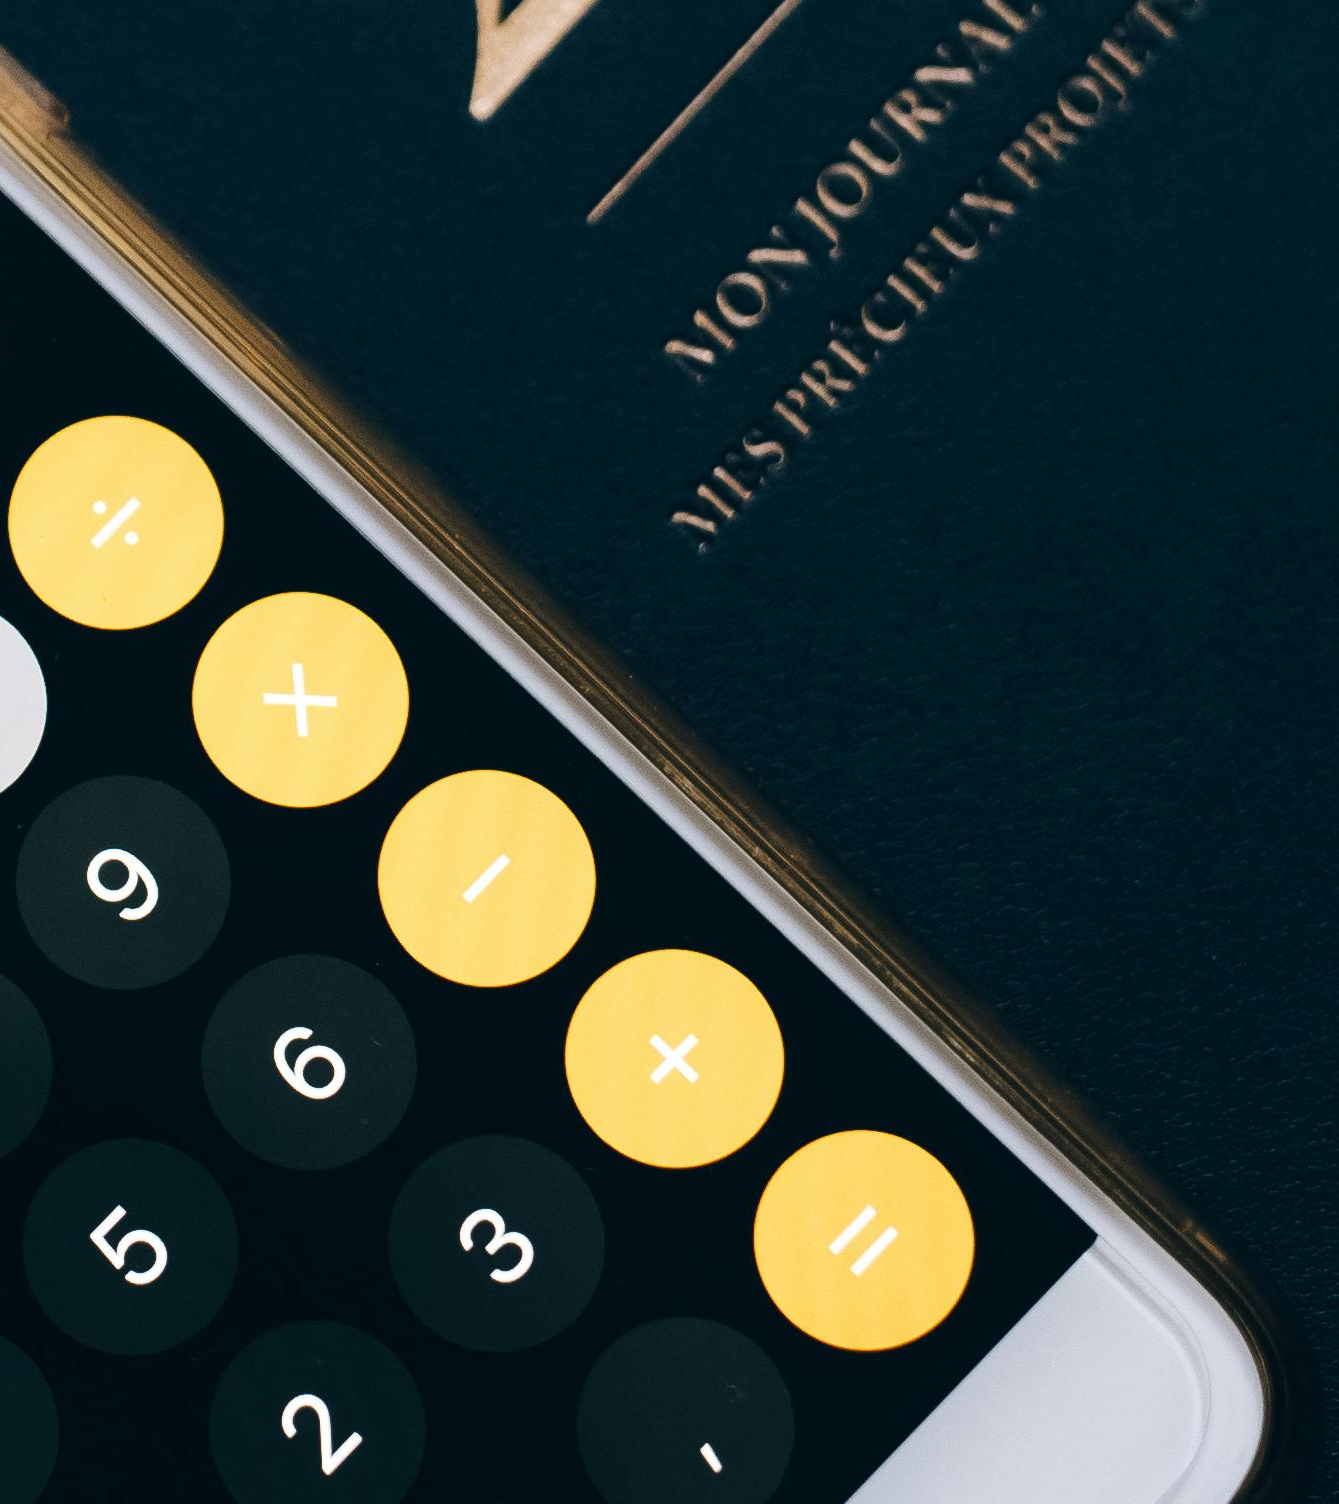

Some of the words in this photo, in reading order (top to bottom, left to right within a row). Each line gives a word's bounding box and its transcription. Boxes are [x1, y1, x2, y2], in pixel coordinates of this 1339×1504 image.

[664, 224, 810, 385] MON
[671, 410, 789, 556] MES
[87, 849, 158, 920] 9
[274, 1027, 346, 1099] 6
[90, 1205, 167, 1284] 5
[460, 1209, 534, 1282] 3
[282, 1394, 362, 1475] 2
